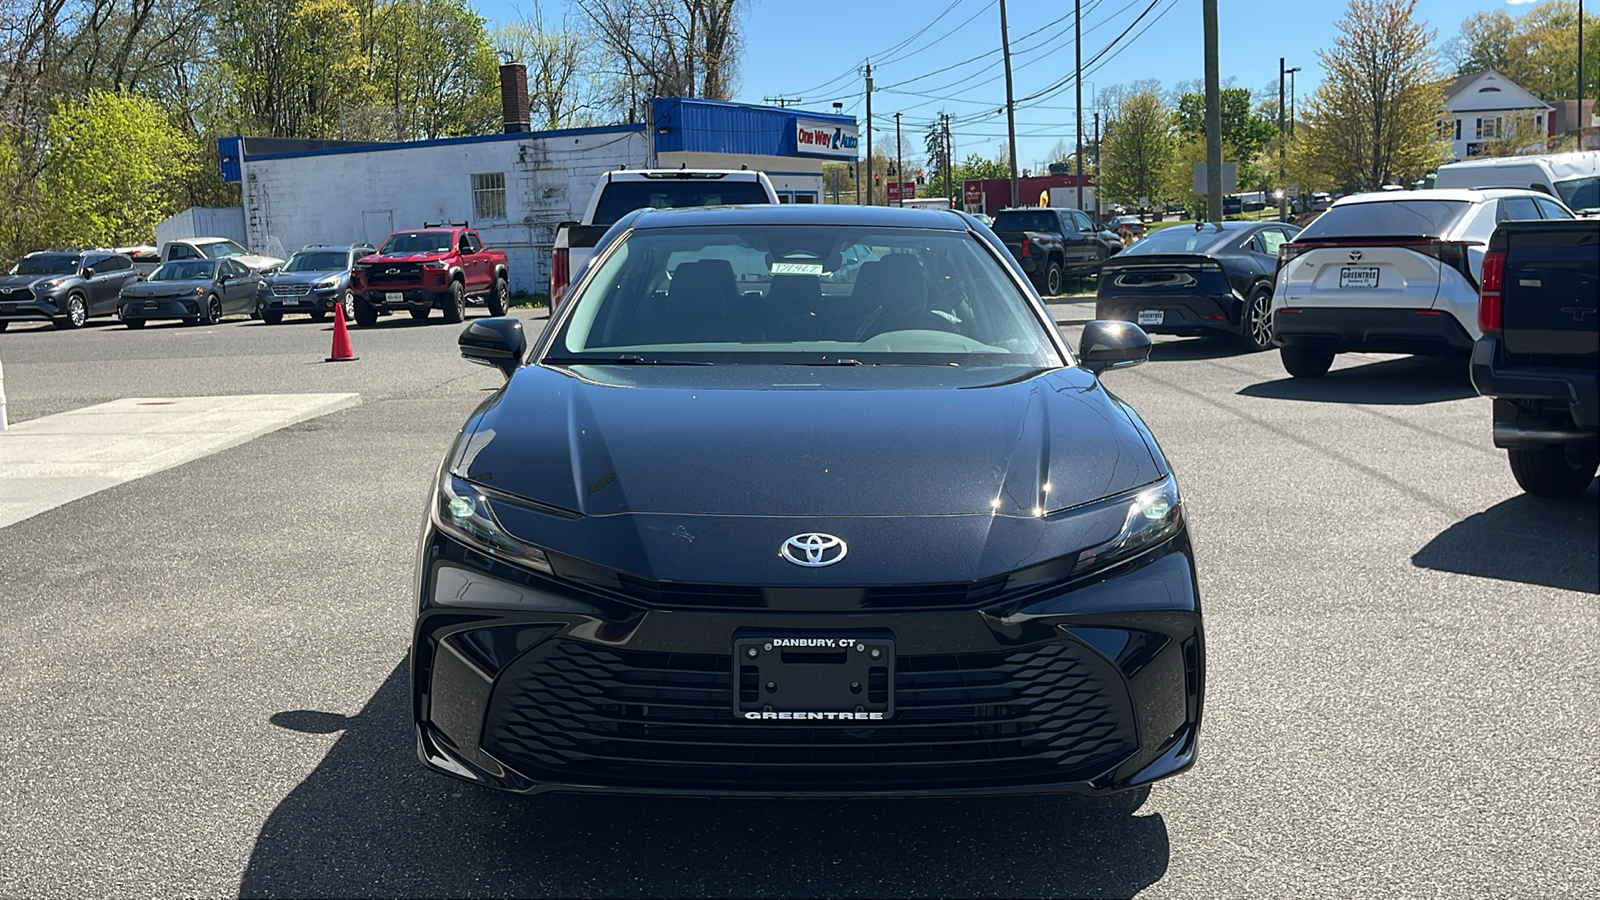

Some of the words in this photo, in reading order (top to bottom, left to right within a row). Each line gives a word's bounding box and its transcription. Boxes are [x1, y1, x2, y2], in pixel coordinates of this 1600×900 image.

[798, 128, 813, 145] One
[814, 130, 832, 148] Way
[840, 133, 858, 149] Auto
[773, 639, 836, 648] DANBURY,
[838, 639, 856, 647] CT
[744, 711, 883, 720] GREENTREE
